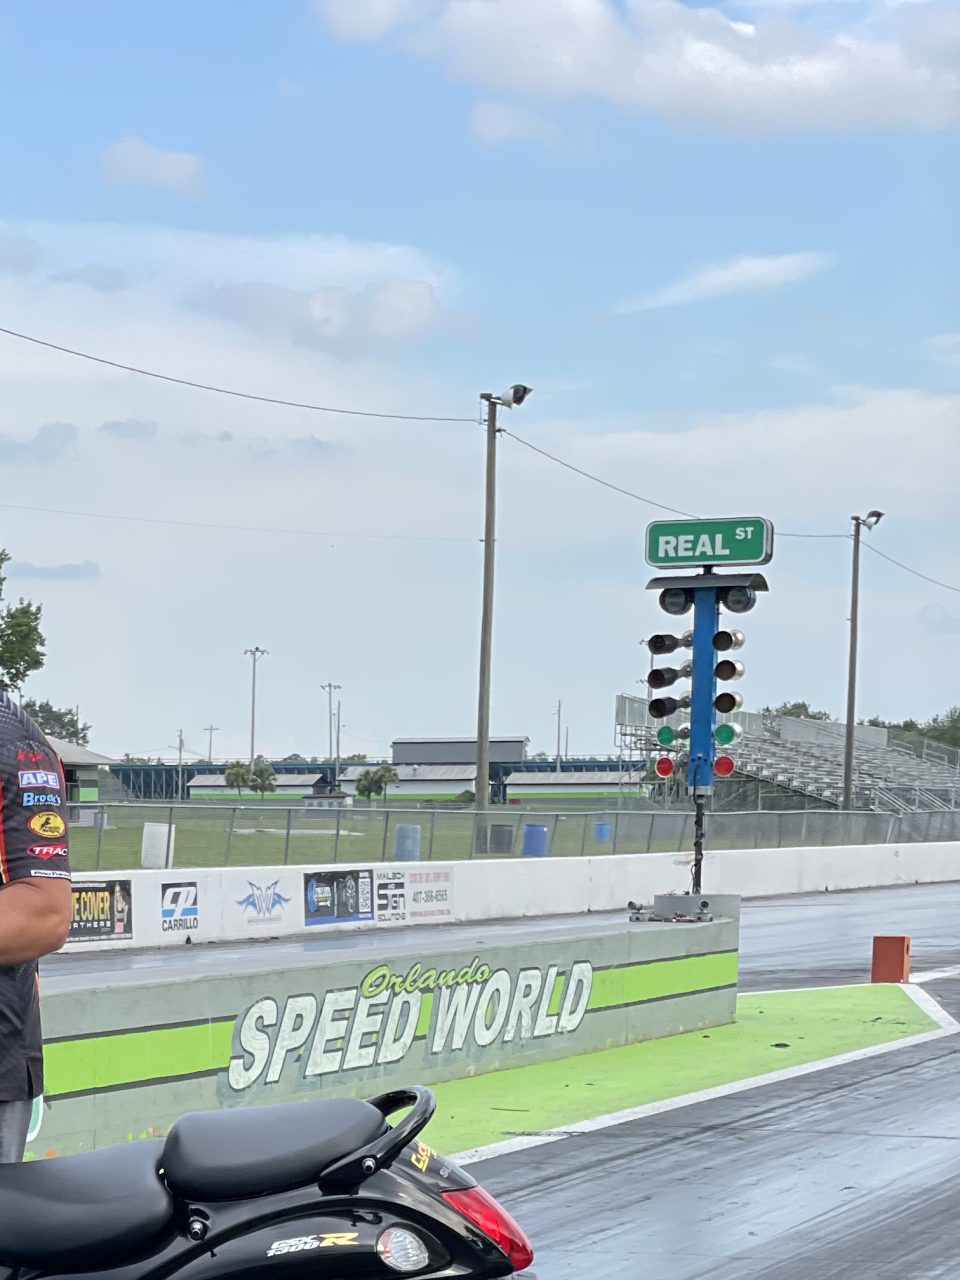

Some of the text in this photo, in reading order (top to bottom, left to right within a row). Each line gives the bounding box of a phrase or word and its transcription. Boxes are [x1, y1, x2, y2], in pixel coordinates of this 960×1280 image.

[657, 527, 754, 558] REAL ST
[21, 773, 58, 786] APE
[80, 891, 111, 920] COVER
[69, 920, 112, 930] ATHERS
[161, 917, 199, 932] CARRILLO
[360, 956, 492, 998] Orlando
[227, 960, 593, 1091] SPEED WORLD
